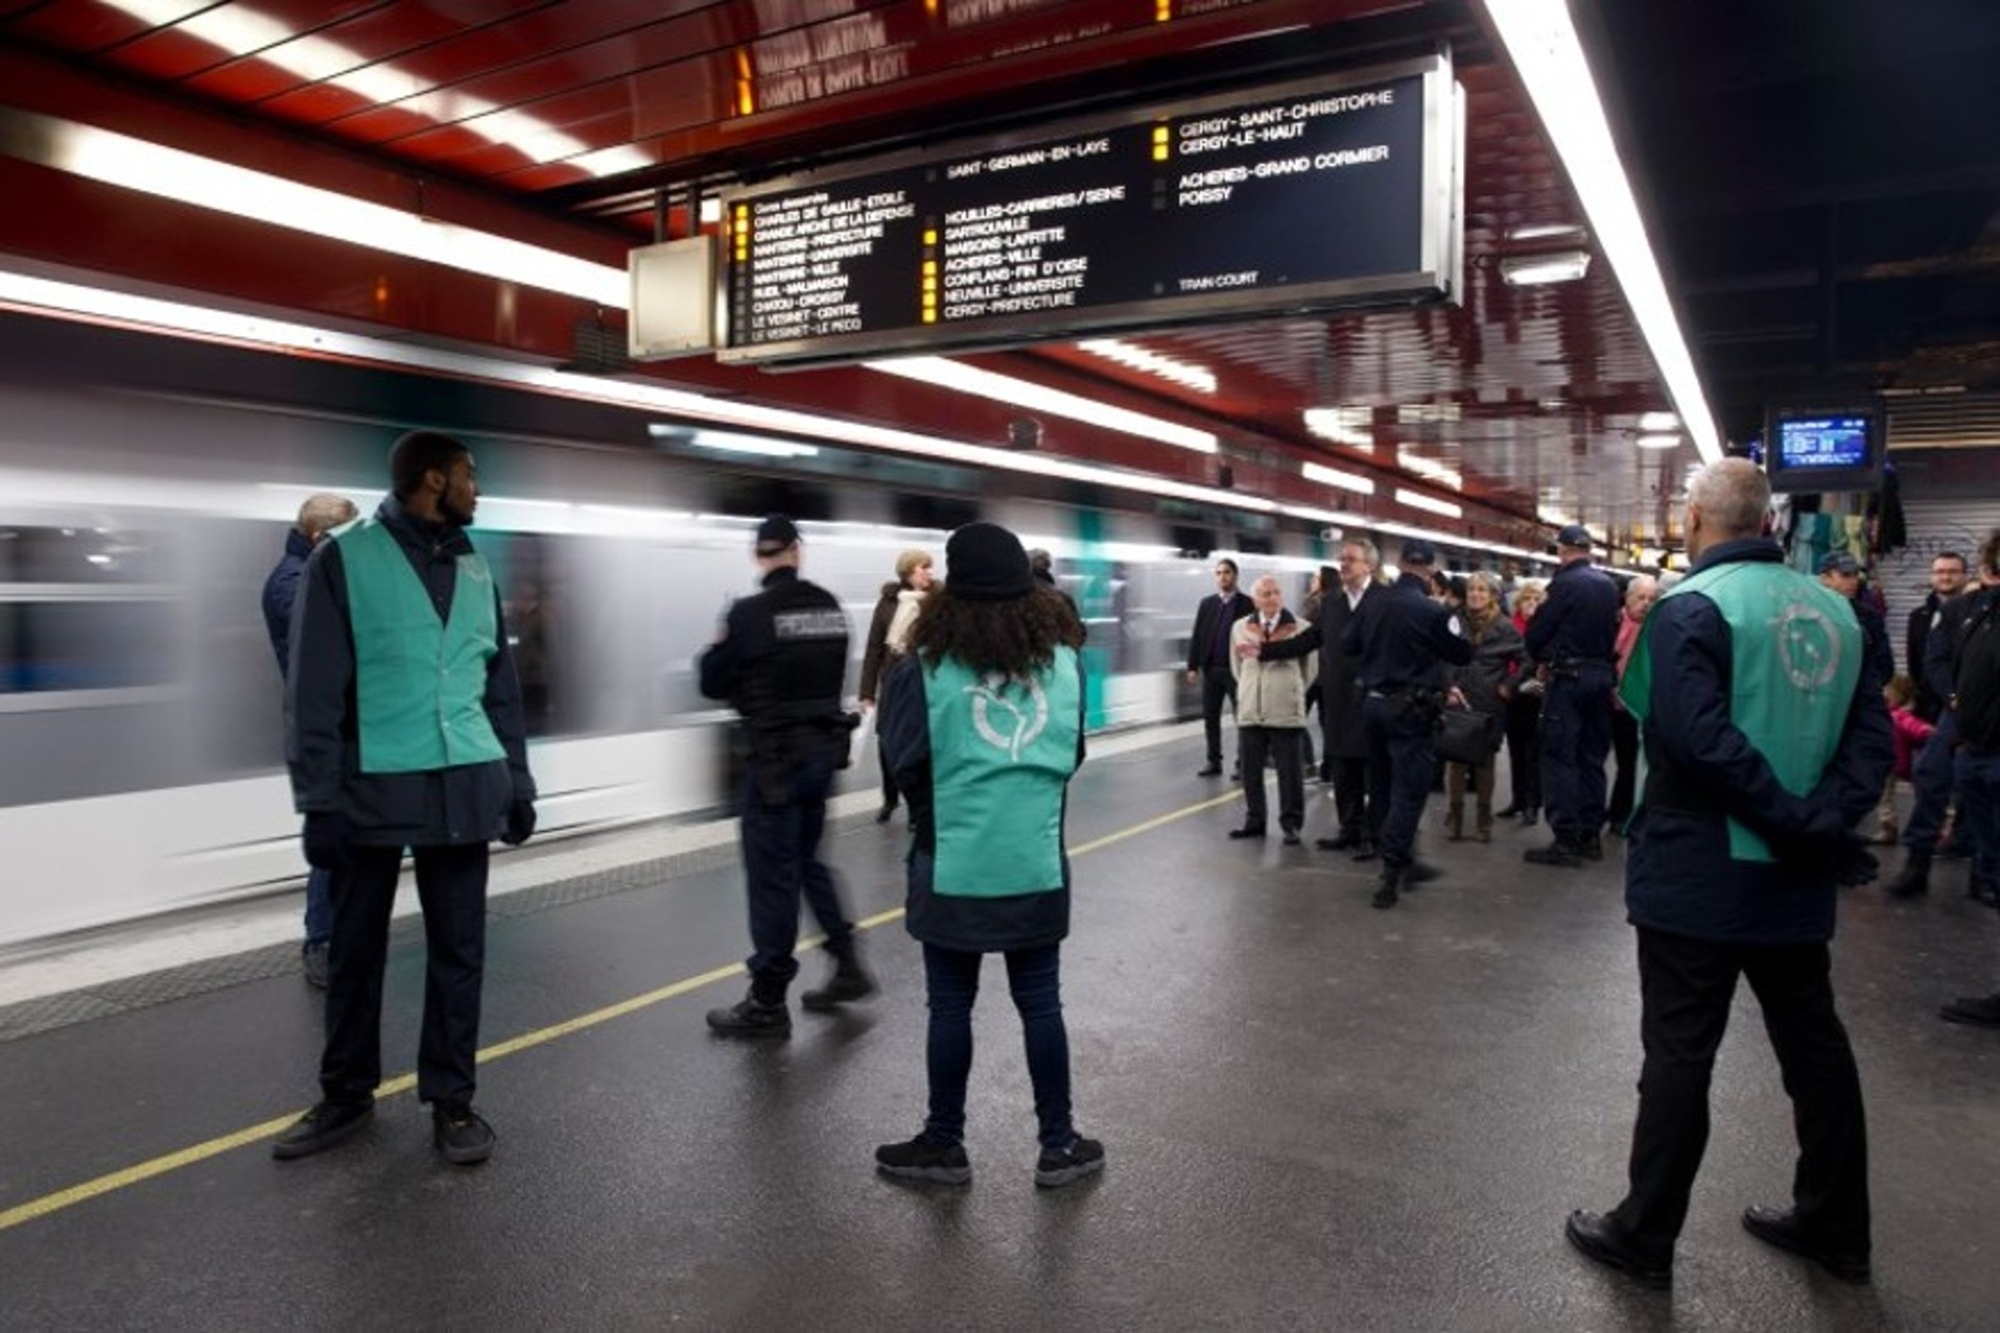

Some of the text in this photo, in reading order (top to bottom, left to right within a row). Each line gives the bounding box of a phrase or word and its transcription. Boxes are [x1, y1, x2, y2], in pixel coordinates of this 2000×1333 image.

[1314, 145, 1389, 169] CORMIER
[1178, 186, 1233, 207] POISSY
[850, 213, 864, 226] LA
[1178, 271, 1259, 291] TRAIN COURT
